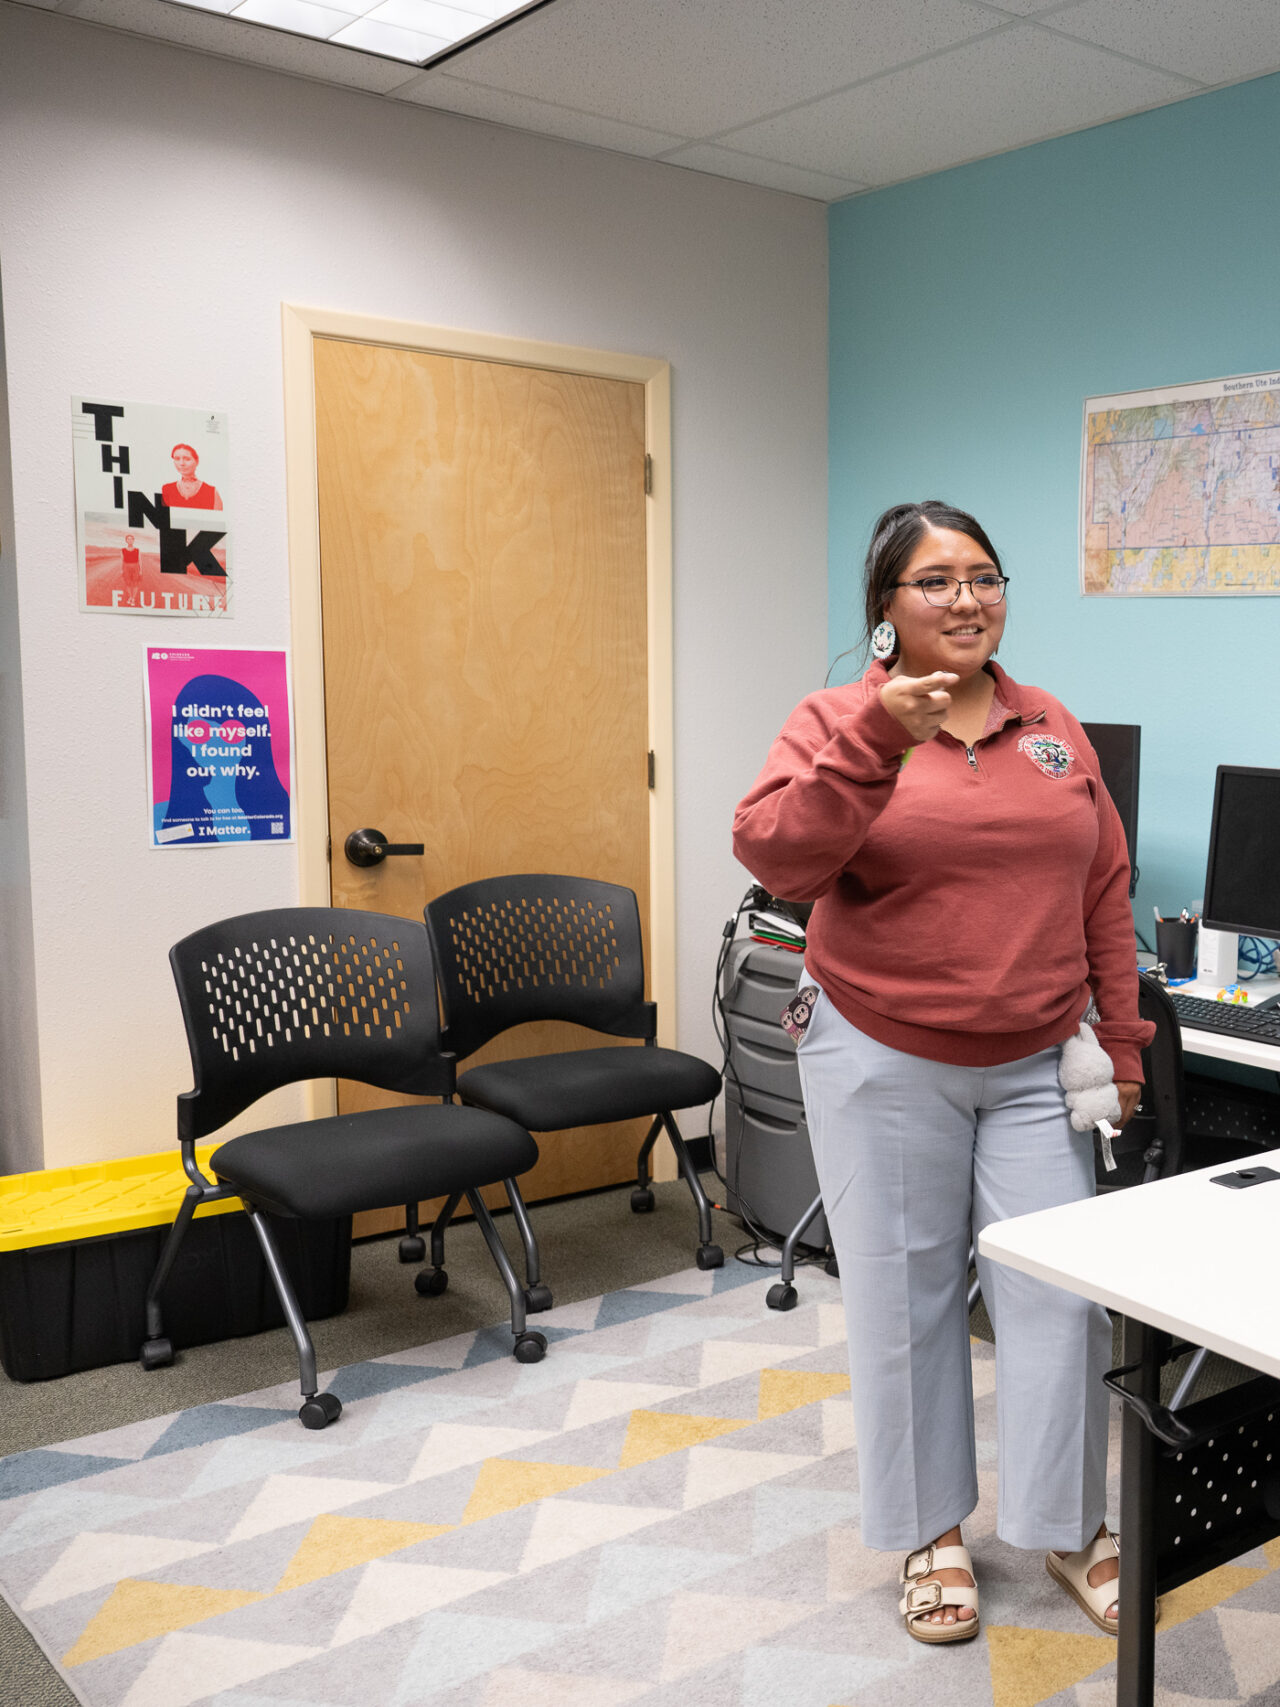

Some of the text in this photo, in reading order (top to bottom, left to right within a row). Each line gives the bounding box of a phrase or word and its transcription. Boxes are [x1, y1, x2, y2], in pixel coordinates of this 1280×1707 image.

[1223, 381, 1254, 392] Southern
[1255, 378, 1267, 388] Ute
[82, 402, 228, 577] THINK
[111, 590, 228, 612] FUTURE
[172, 704, 177, 718] I
[237, 704, 269, 718] feel
[173, 724, 272, 741] like myself.
[191, 743, 252, 757] I found
[186, 764, 260, 780] out why.
[198, 825, 251, 836] I Matter.
